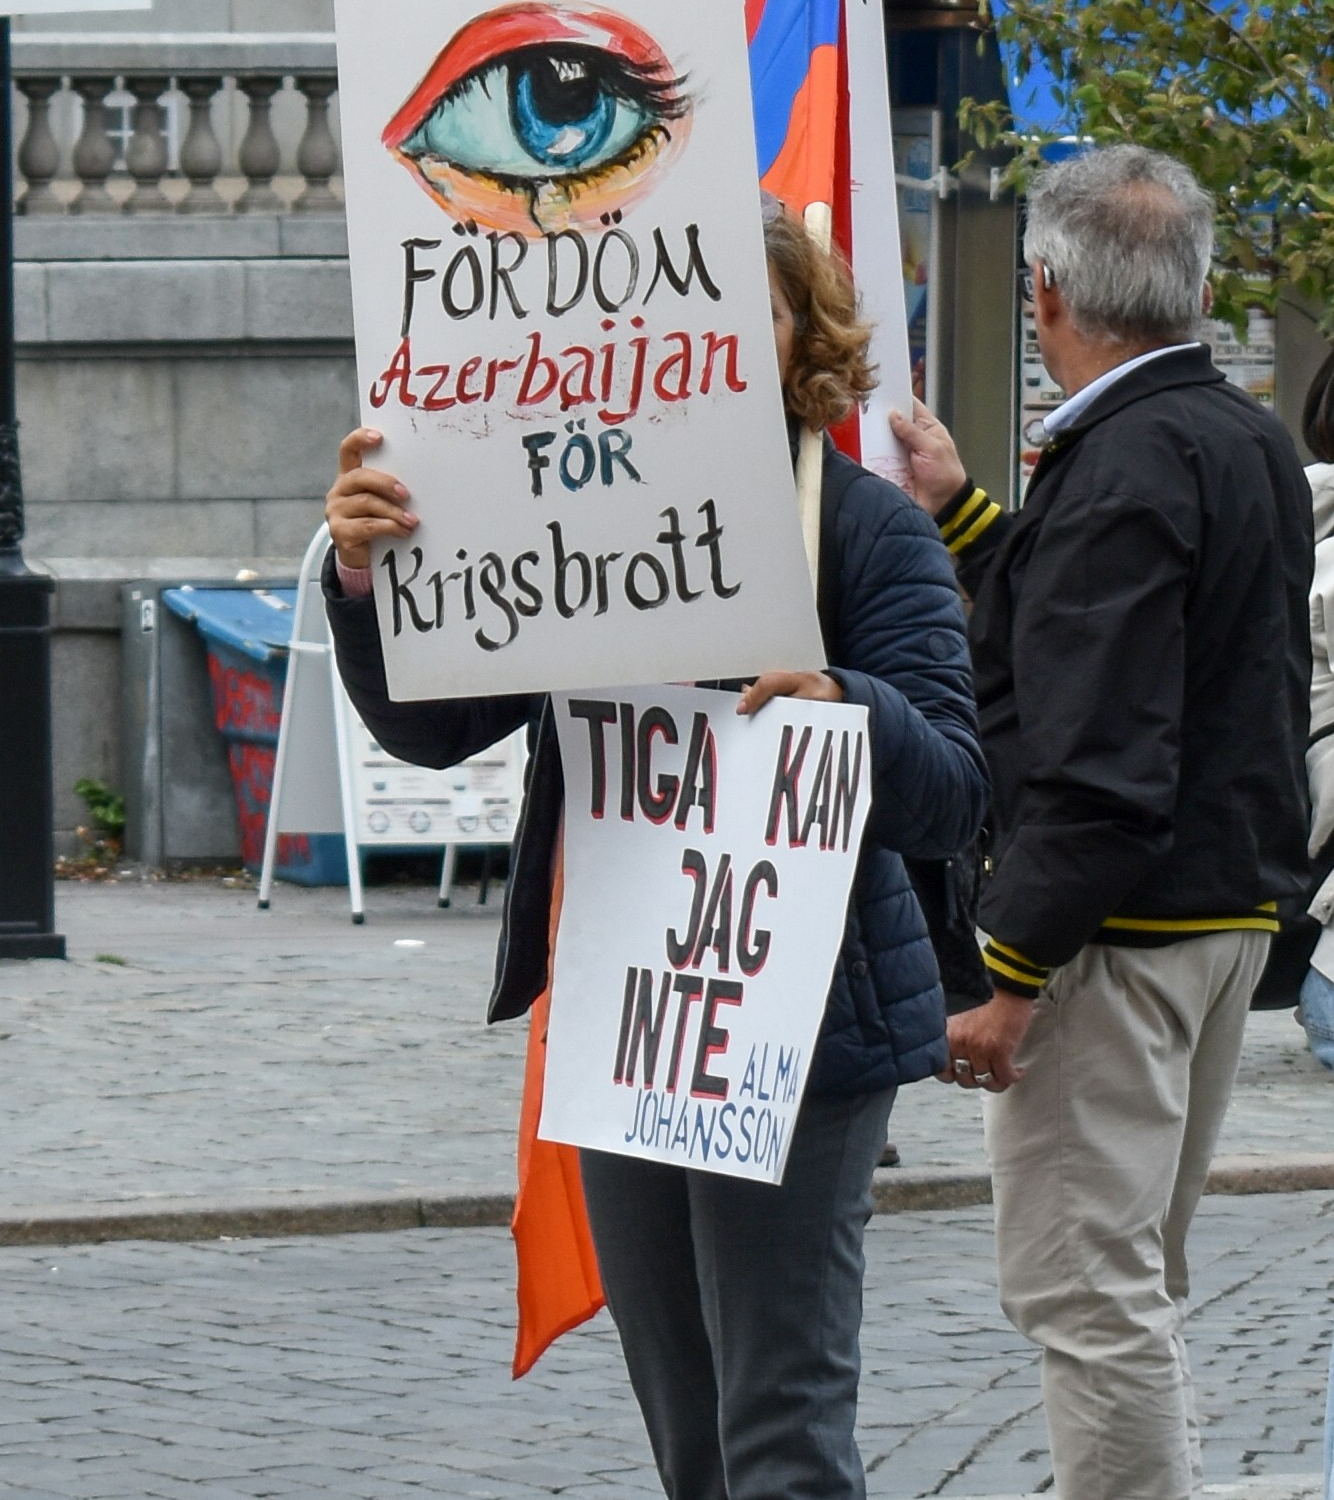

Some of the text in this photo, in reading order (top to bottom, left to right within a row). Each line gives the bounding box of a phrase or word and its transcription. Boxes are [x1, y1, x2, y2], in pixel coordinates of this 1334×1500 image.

[370, 315, 748, 426] Azerbaijan
[521, 418, 649, 498] FÖR
[380, 498, 742, 652] Krigsbrott
[568, 698, 718, 835] TIGA
[764, 724, 863, 853] KAN
[666, 848, 778, 977] JAG
[613, 966, 744, 1101] INTE
[739, 1042, 801, 1104] ALMA
[624, 1088, 786, 1171] JOHANSSON
